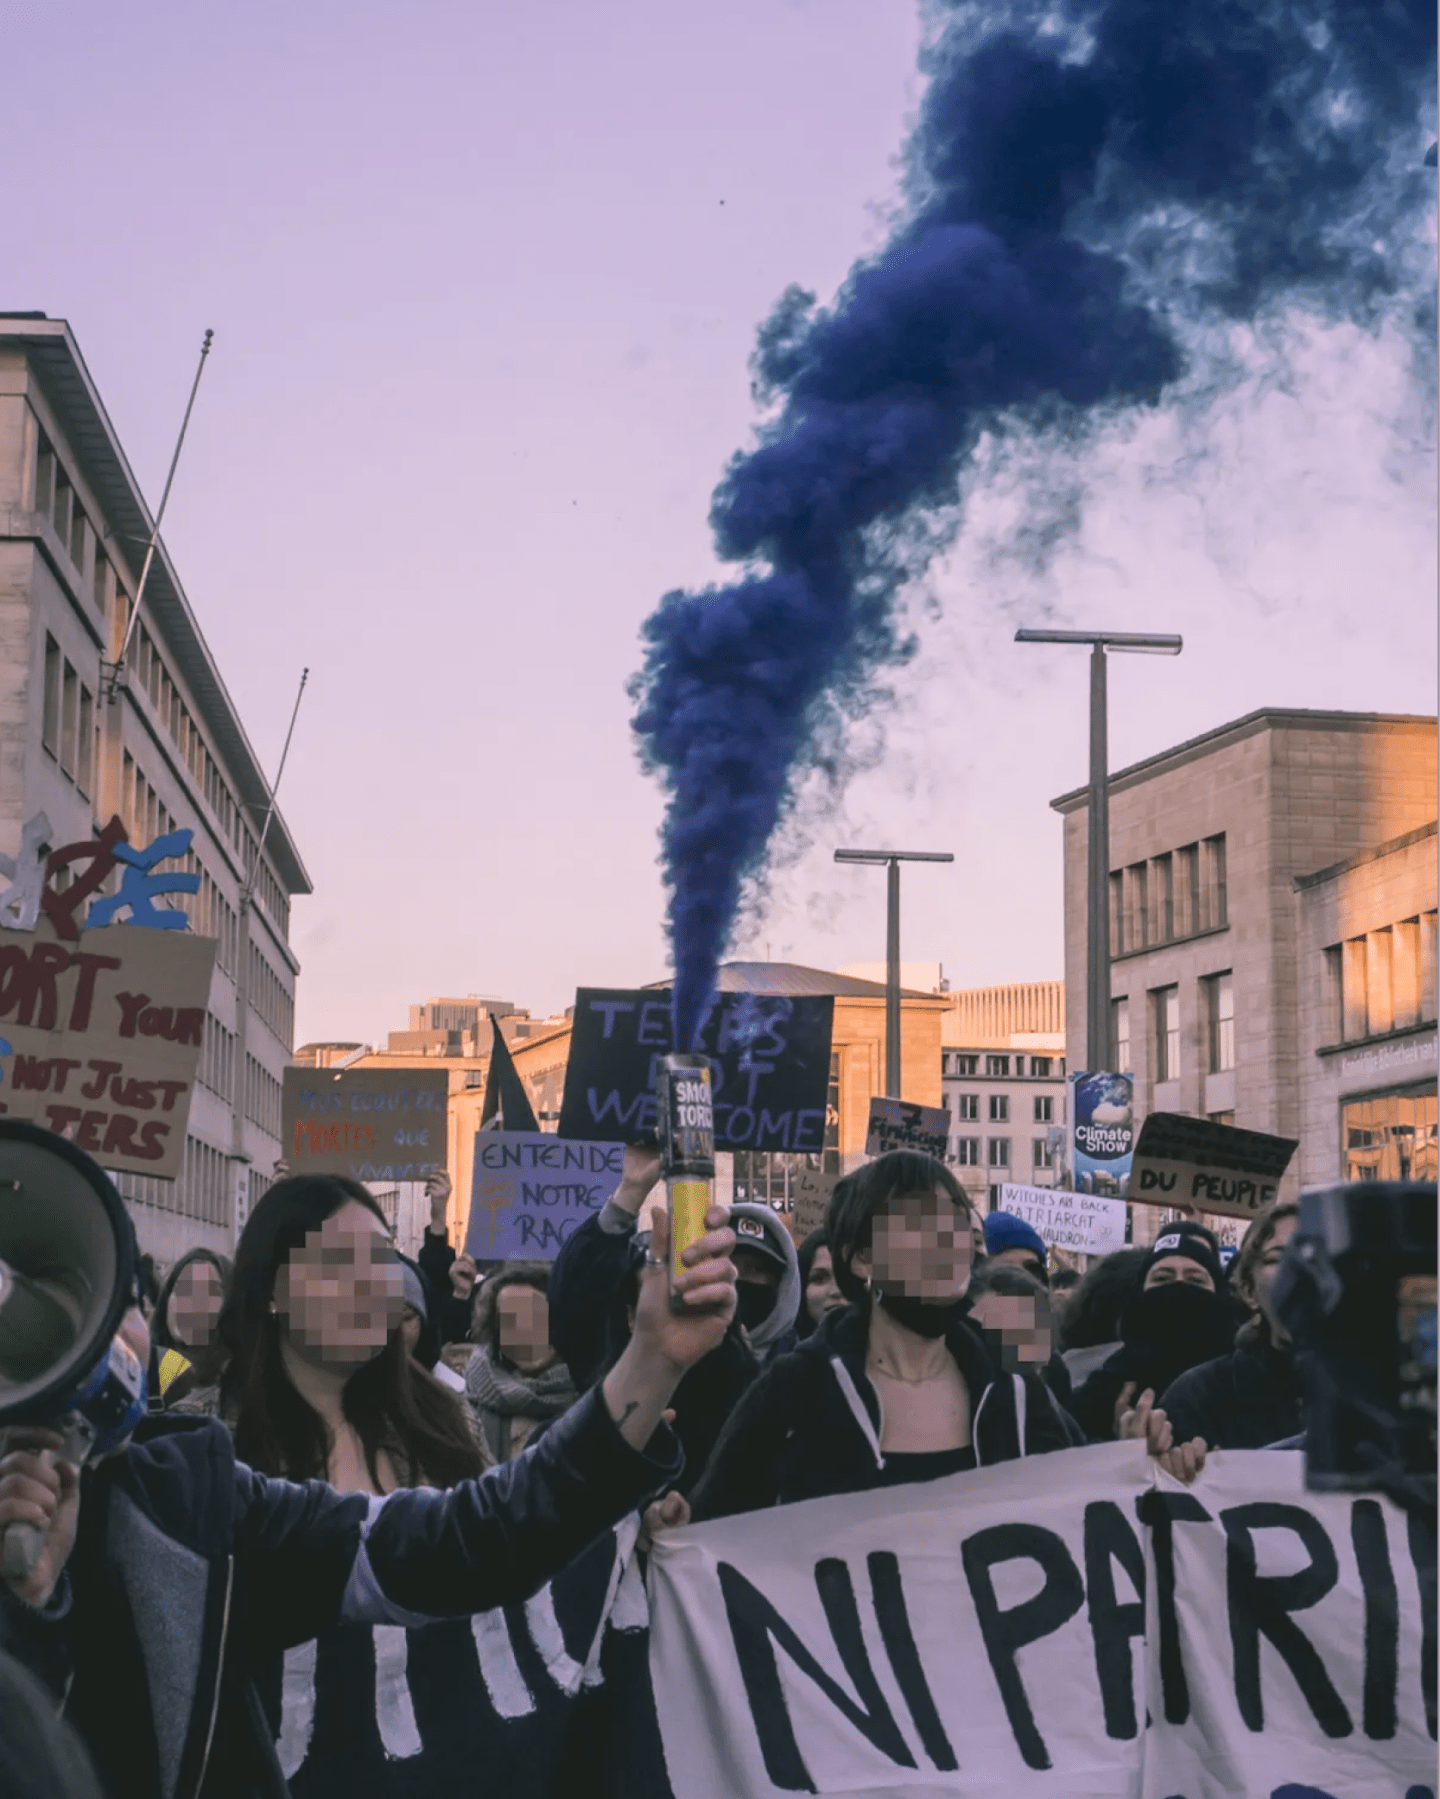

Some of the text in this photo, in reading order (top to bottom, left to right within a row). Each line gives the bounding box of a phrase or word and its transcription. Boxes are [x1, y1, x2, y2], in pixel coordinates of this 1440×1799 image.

[12, 1054, 81, 1094] NOT
[81, 1059, 188, 1112] JUST
[20, 1104, 172, 1161] TERS
[393, 1128, 430, 1147] QUE
[1075, 1125, 1132, 1141] Climate
[1086, 1138, 1127, 1152] Show
[1140, 1169, 1178, 1192] DU
[522, 1182, 604, 1210] NOTRE
[1005, 1187, 1056, 1207] WITCHES
[1081, 1199, 1110, 1214] BACK
[716, 1550, 960, 1794] NI
